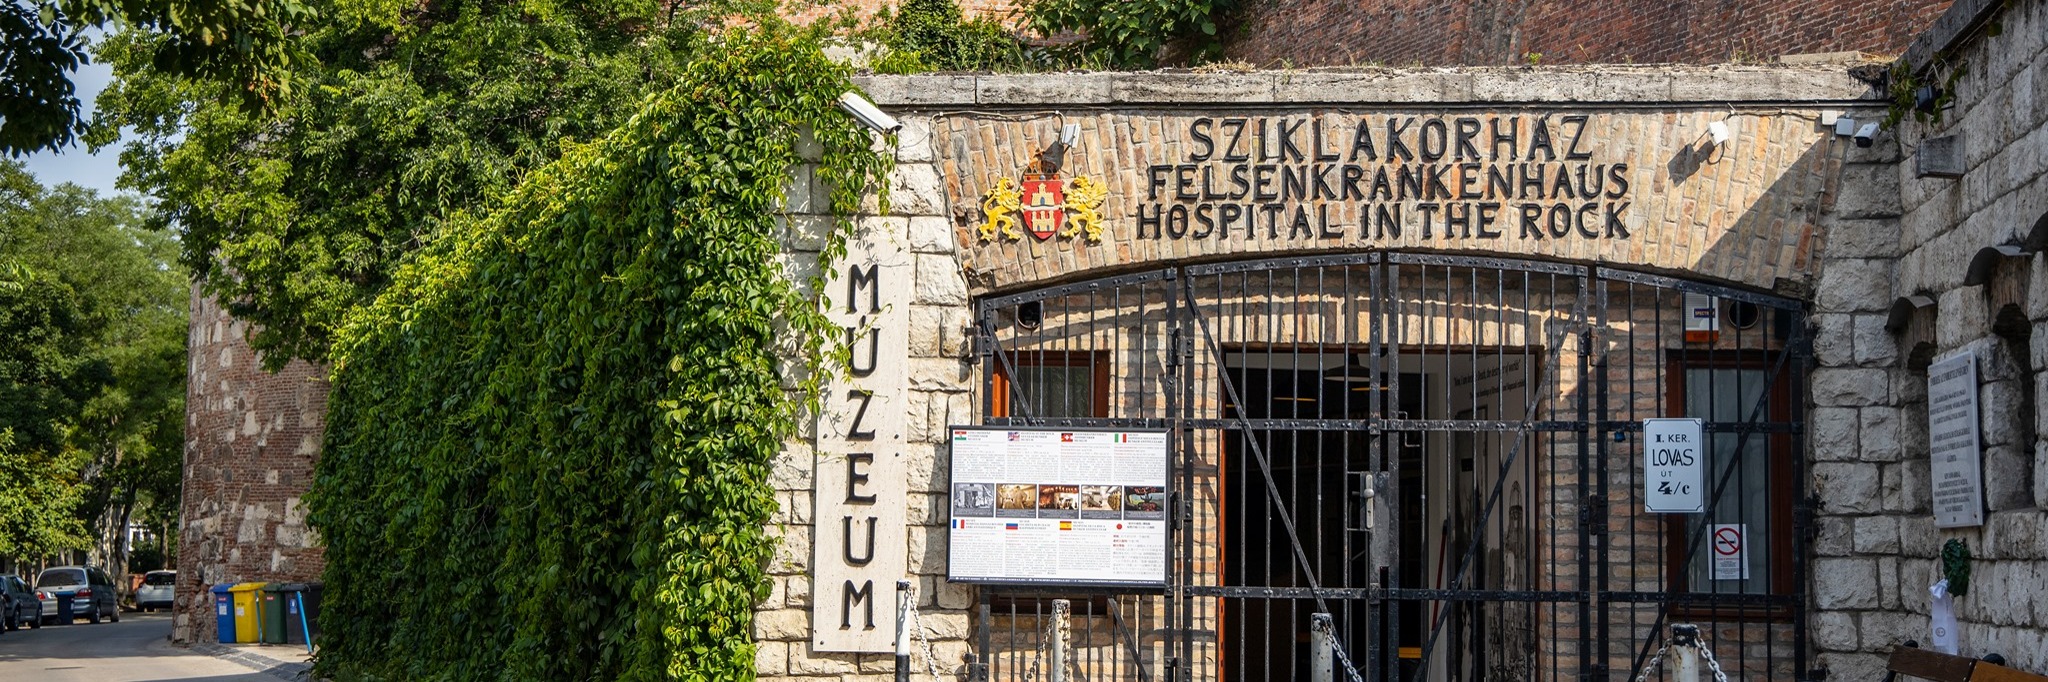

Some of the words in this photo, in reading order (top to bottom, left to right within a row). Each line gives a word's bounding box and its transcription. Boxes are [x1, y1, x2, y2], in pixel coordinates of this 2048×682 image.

[1148, 163, 1629, 200] FELSENKRANKENHAUS
[1136, 203, 1344, 240] HOSPITAL
[1360, 202, 1402, 240] IN
[1416, 202, 1502, 240] THE
[1519, 202, 1631, 240] ROCK
[838, 263, 880, 630] MÚZEUM
[1668, 434, 1690, 443] KER.
[1652, 448, 1694, 467] LOVAS
[1660, 469, 1673, 478] ÚT
